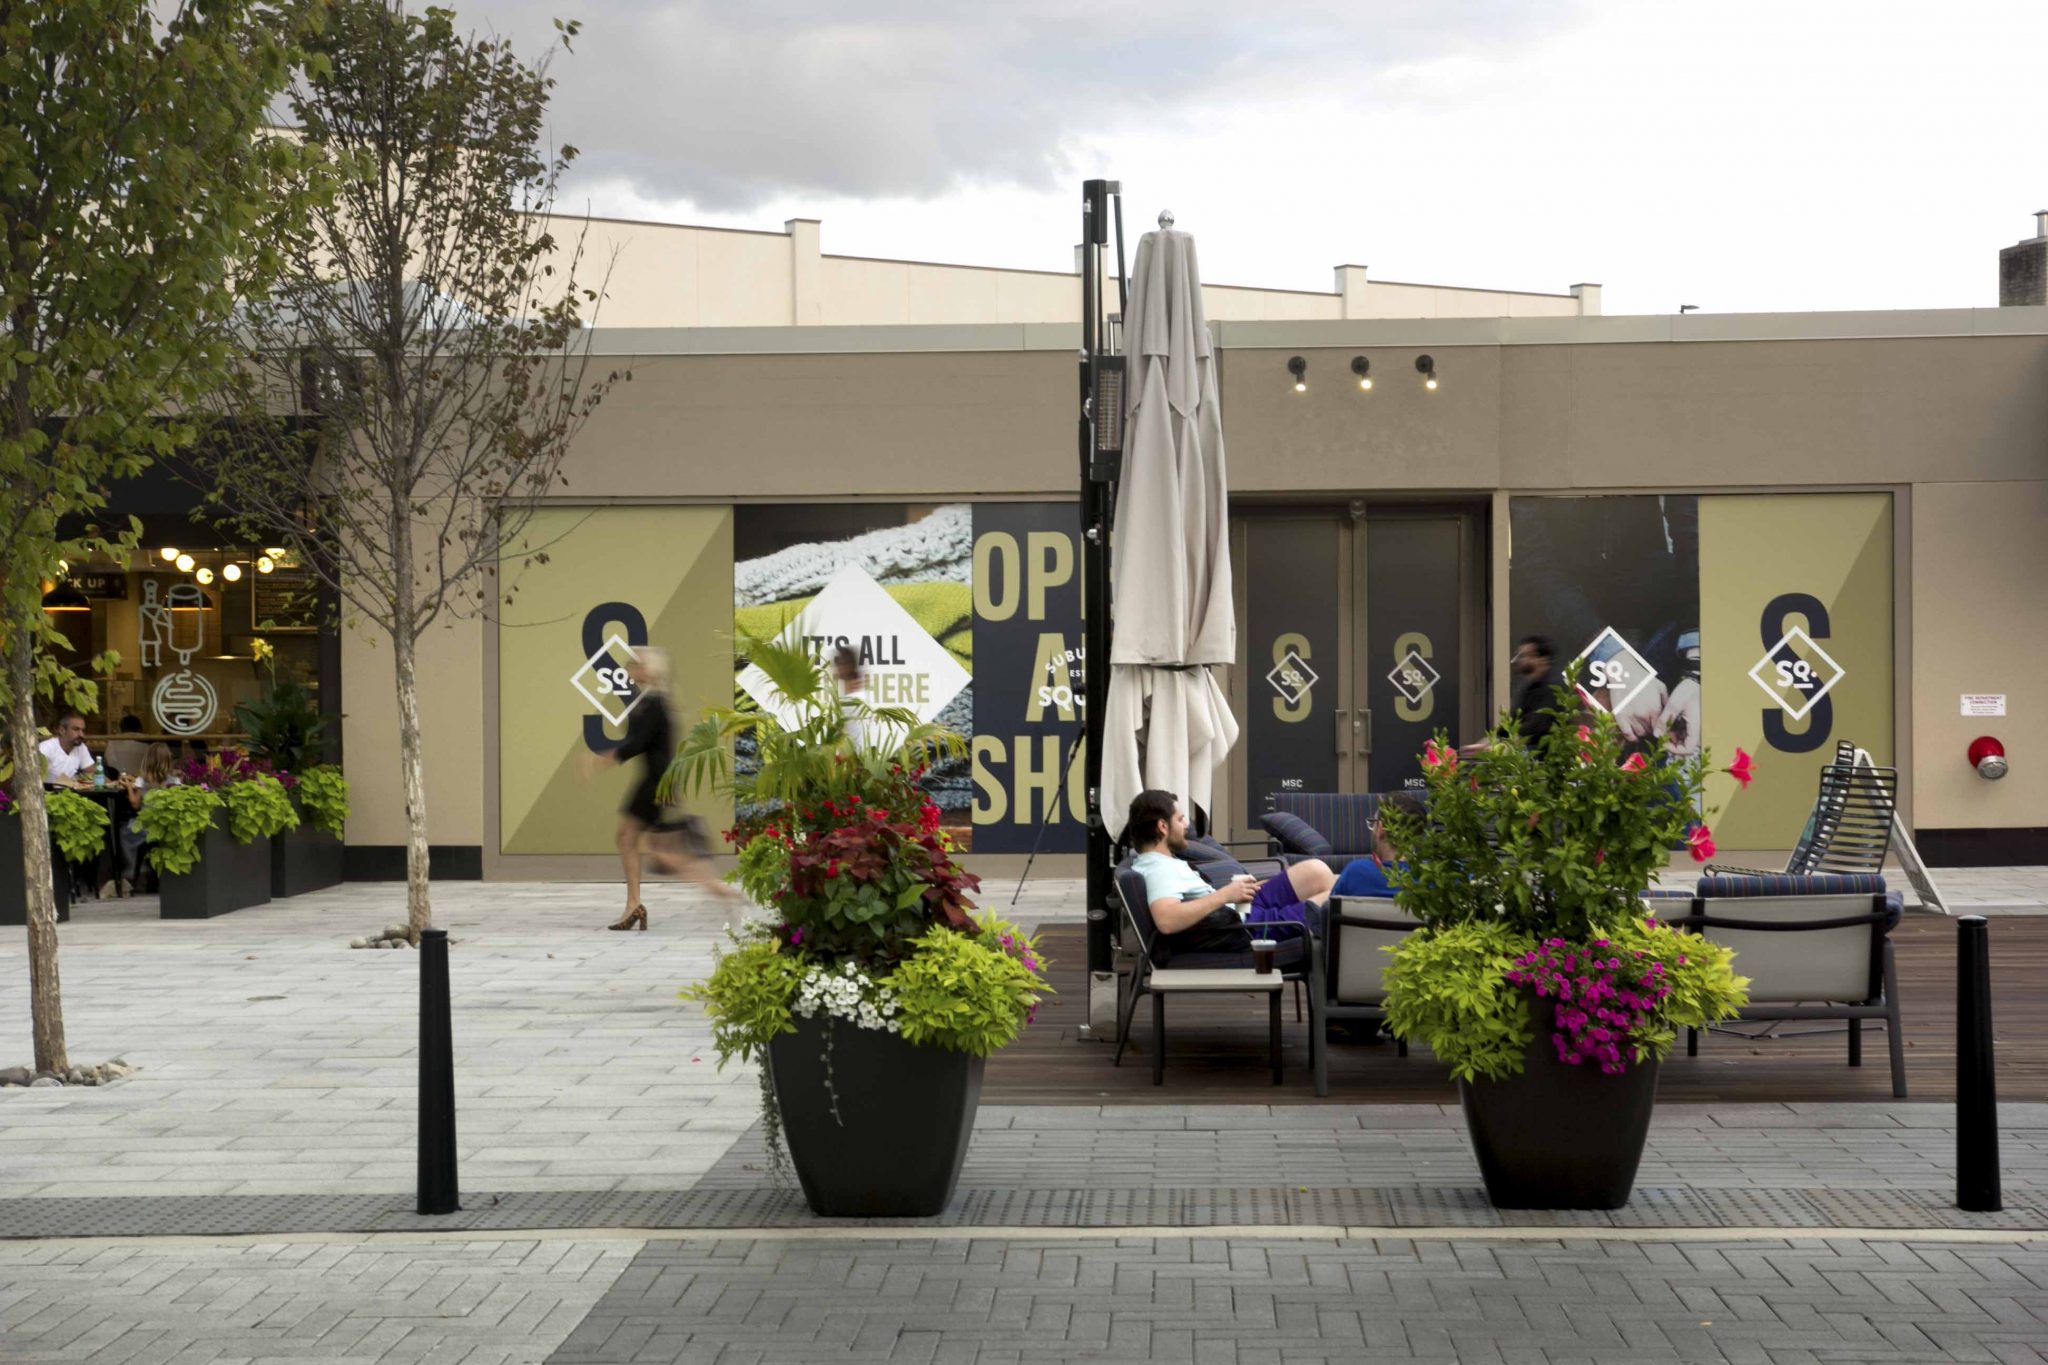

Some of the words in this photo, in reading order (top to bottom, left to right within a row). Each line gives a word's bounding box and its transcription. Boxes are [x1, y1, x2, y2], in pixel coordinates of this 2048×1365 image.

[972, 531, 1086, 621] OP
[858, 635, 906, 666] ALL
[864, 673, 930, 704] HERE
[1282, 779, 1303, 788] MSC
[1404, 778, 1425, 787] MSC
